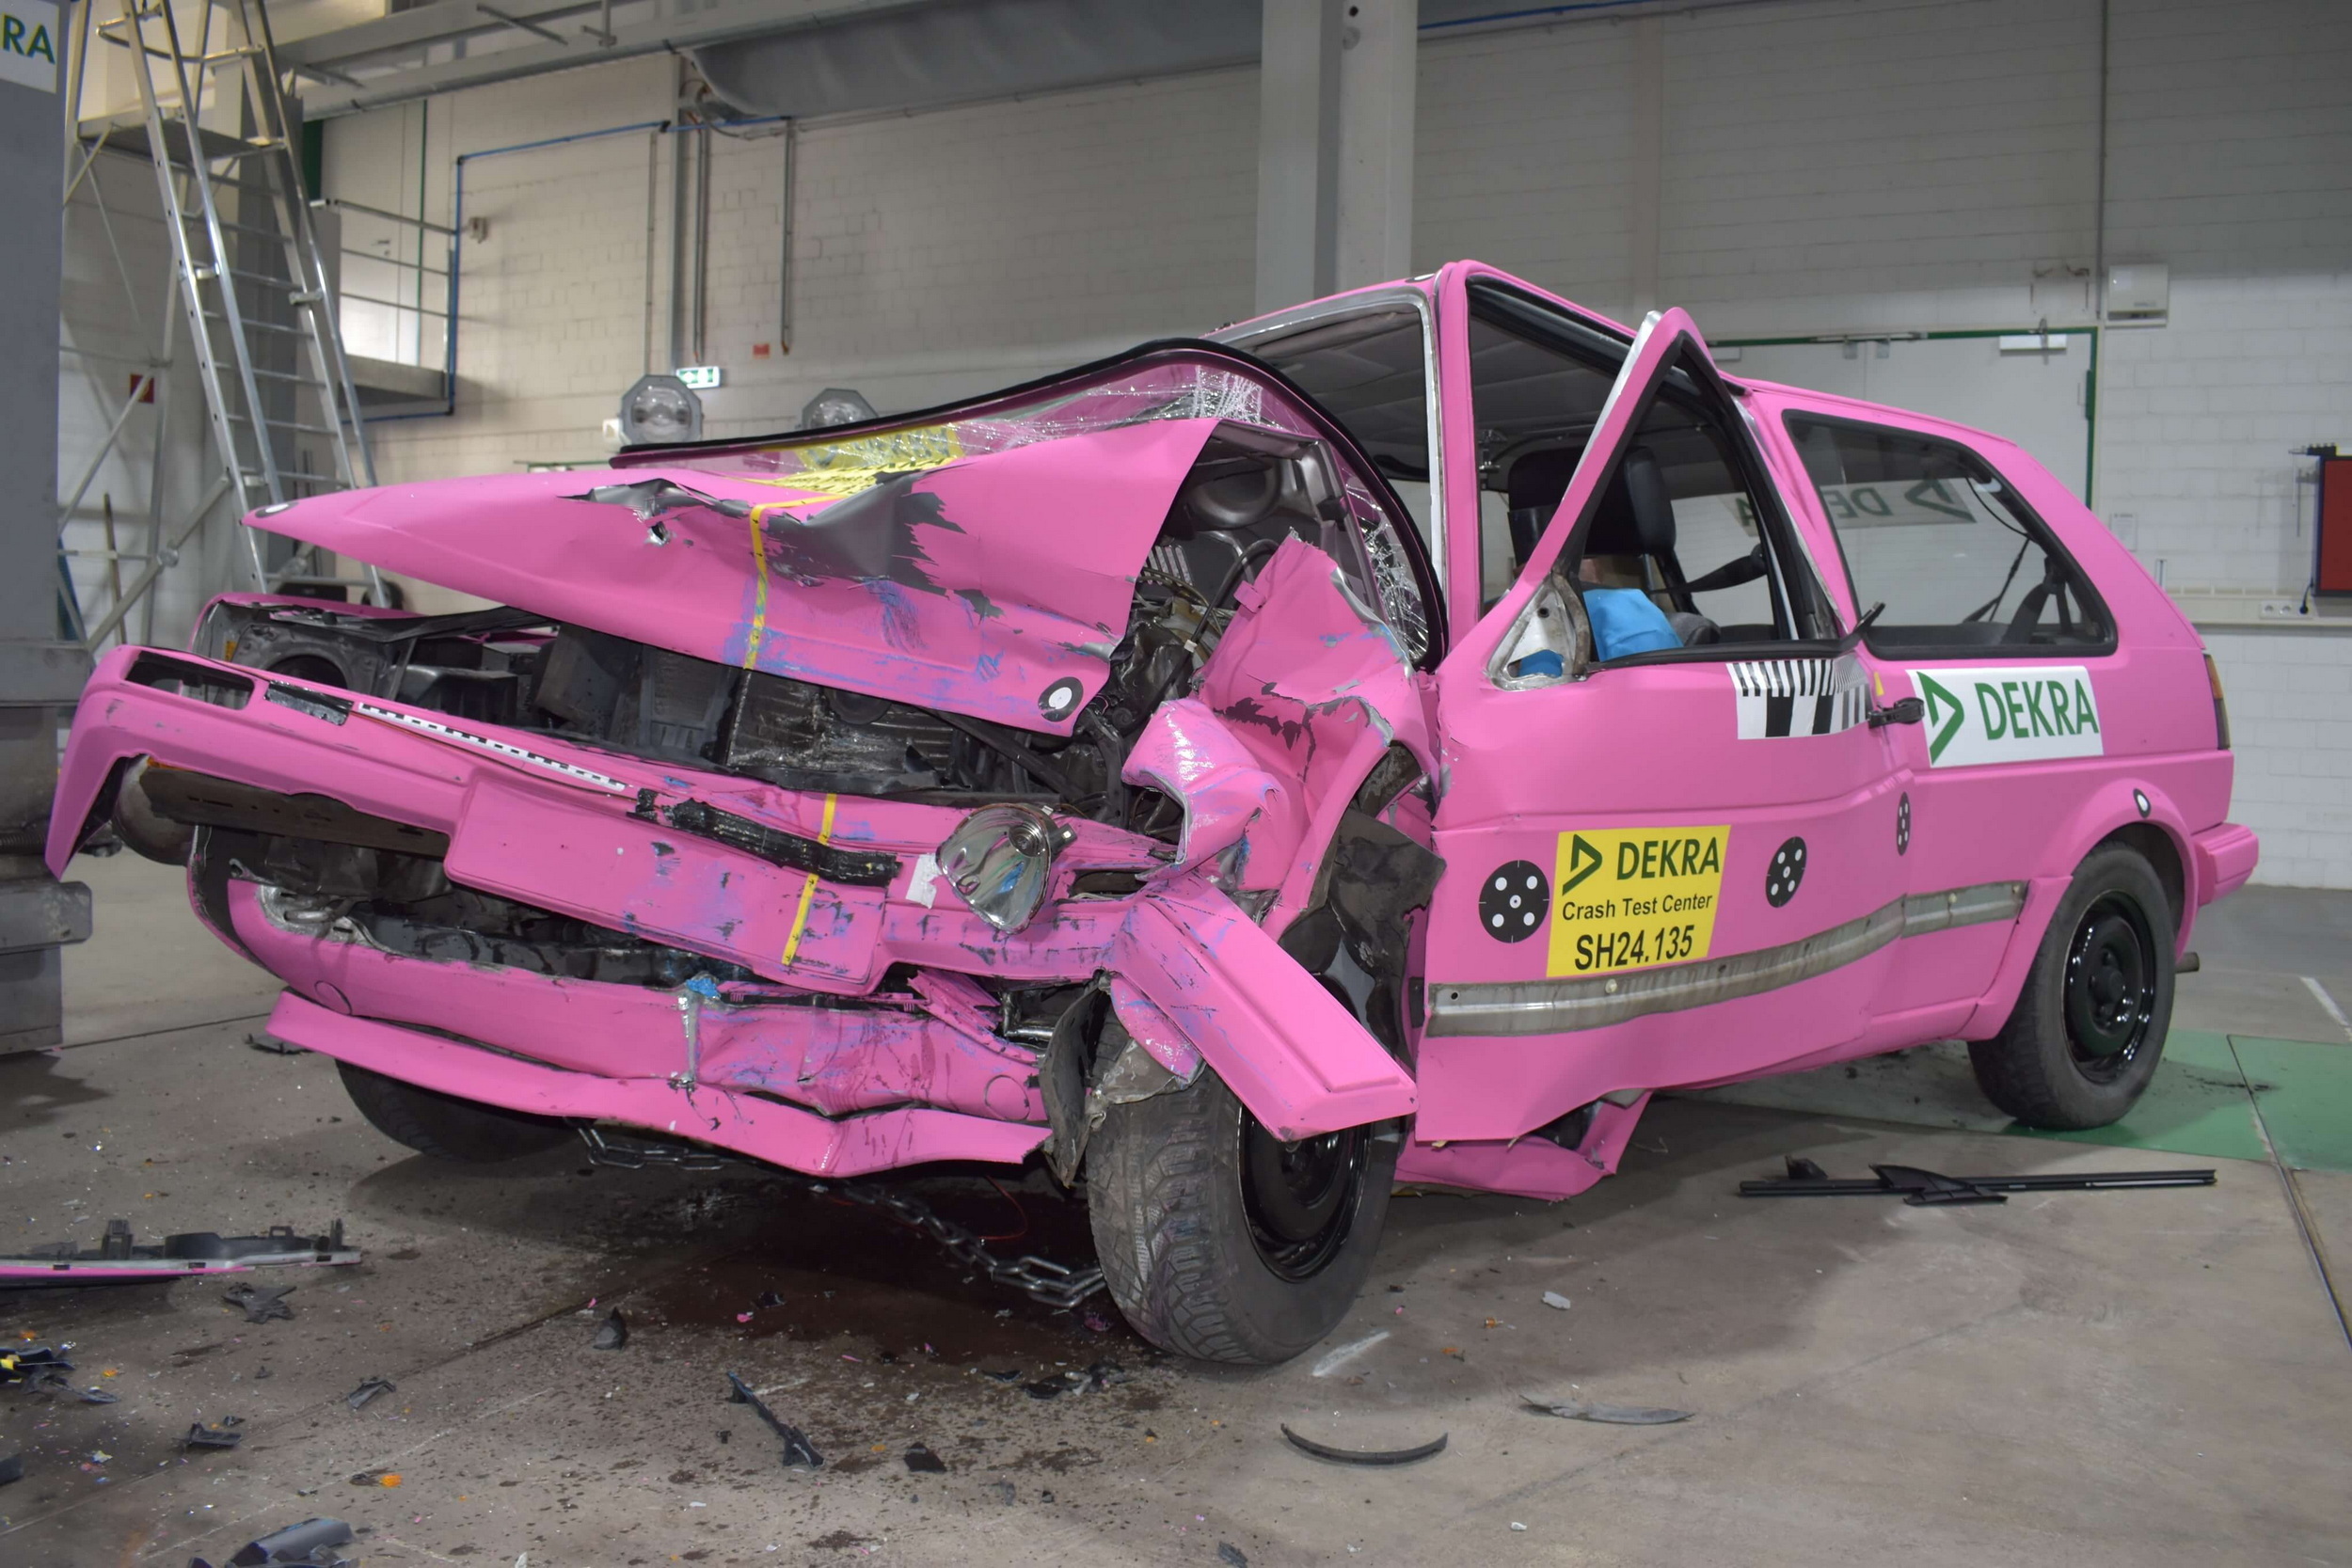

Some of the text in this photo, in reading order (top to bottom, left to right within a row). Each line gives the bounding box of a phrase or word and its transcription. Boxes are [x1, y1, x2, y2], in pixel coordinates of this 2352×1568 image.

[2, 14, 56, 66] RA
[1974, 678, 2100, 741] DEKRA
[1616, 836, 1720, 880] DEKRA
[1562, 894, 1713, 921] Crash Test Center
[1574, 924, 1695, 972] SH24.135
